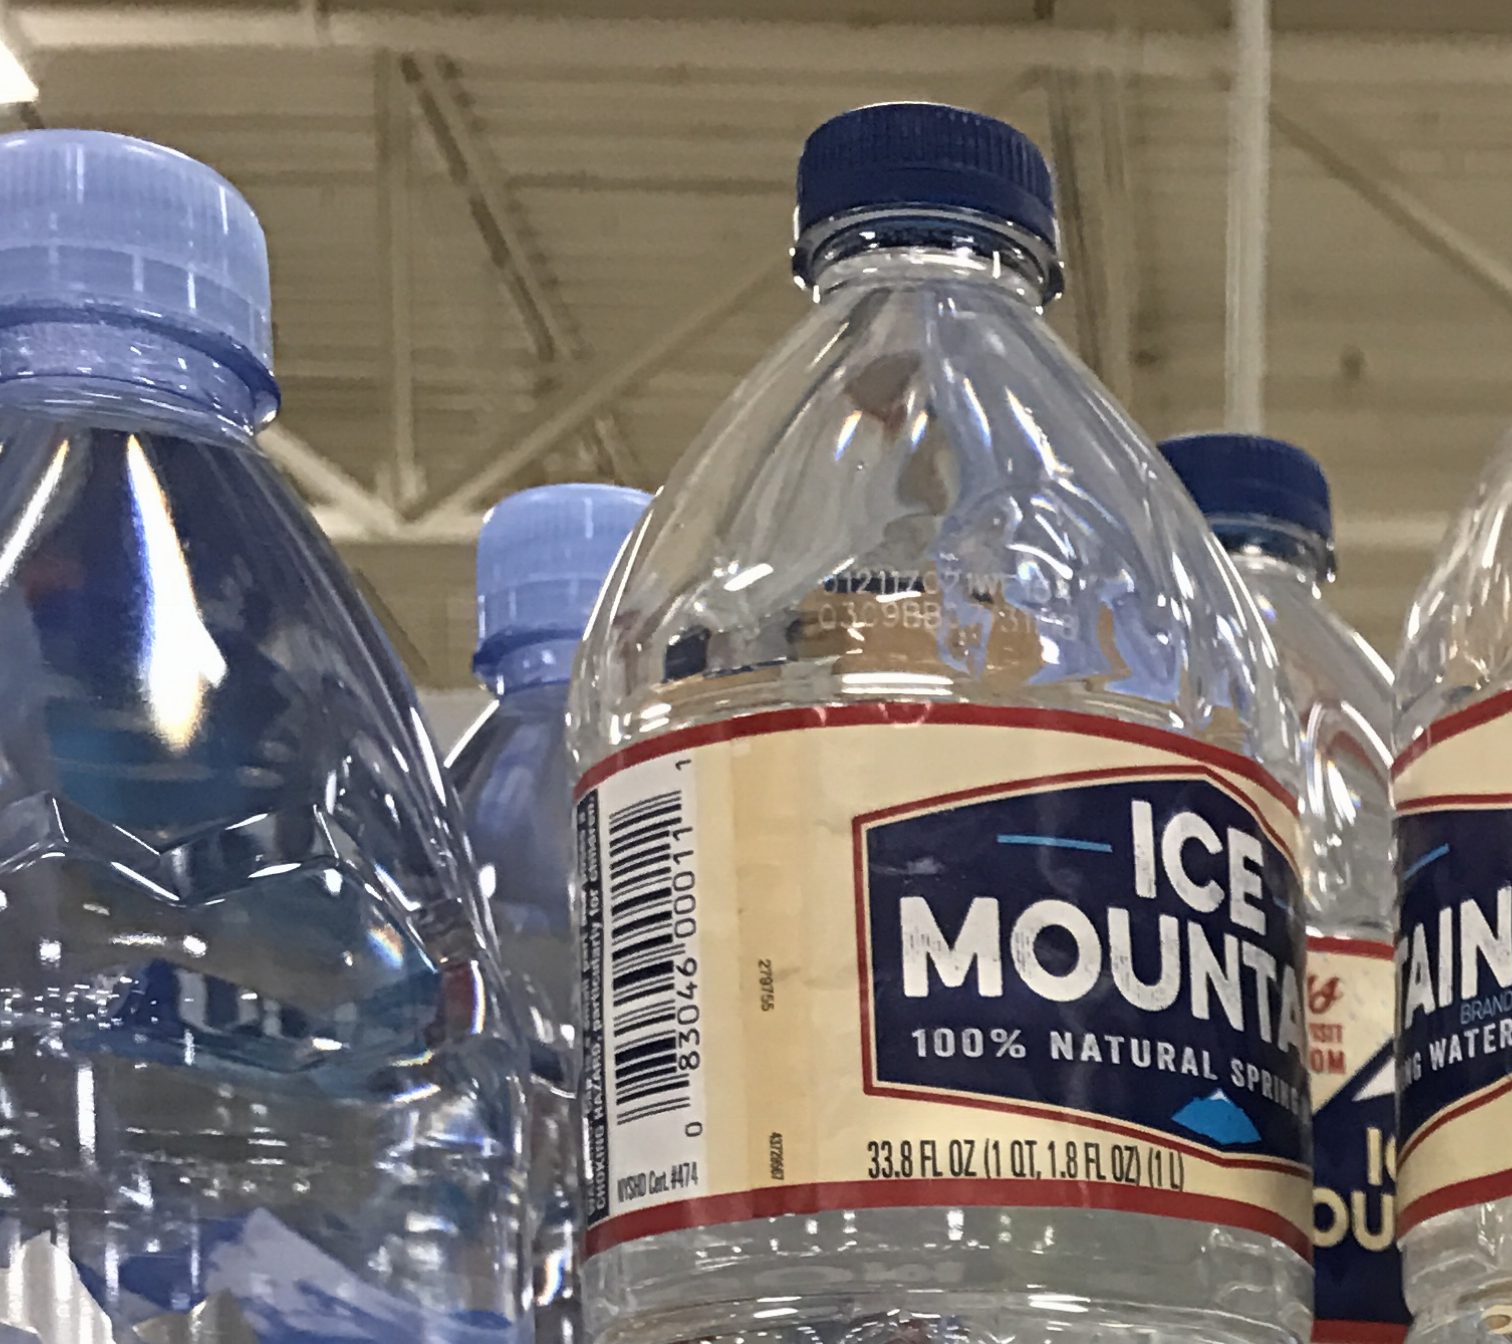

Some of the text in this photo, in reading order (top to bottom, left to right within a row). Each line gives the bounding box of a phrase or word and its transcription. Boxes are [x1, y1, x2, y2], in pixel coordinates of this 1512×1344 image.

[672, 826, 698, 939] 00011
[1130, 800, 1265, 937] ICE
[676, 956, 701, 1071] 83046
[912, 1027, 1027, 1061] 100%
[1050, 1031, 1219, 1081] NATURAL
[867, 1140, 913, 1179] 33.8
[920, 1140, 945, 1179] FL
[949, 1139, 976, 1179] OZ
[983, 1139, 1001, 1180] (1
[1046, 1140, 1077, 1181] 1.8
[1084, 1142, 1107, 1181] FL
[1111, 1144, 1142, 1186] OZ)
